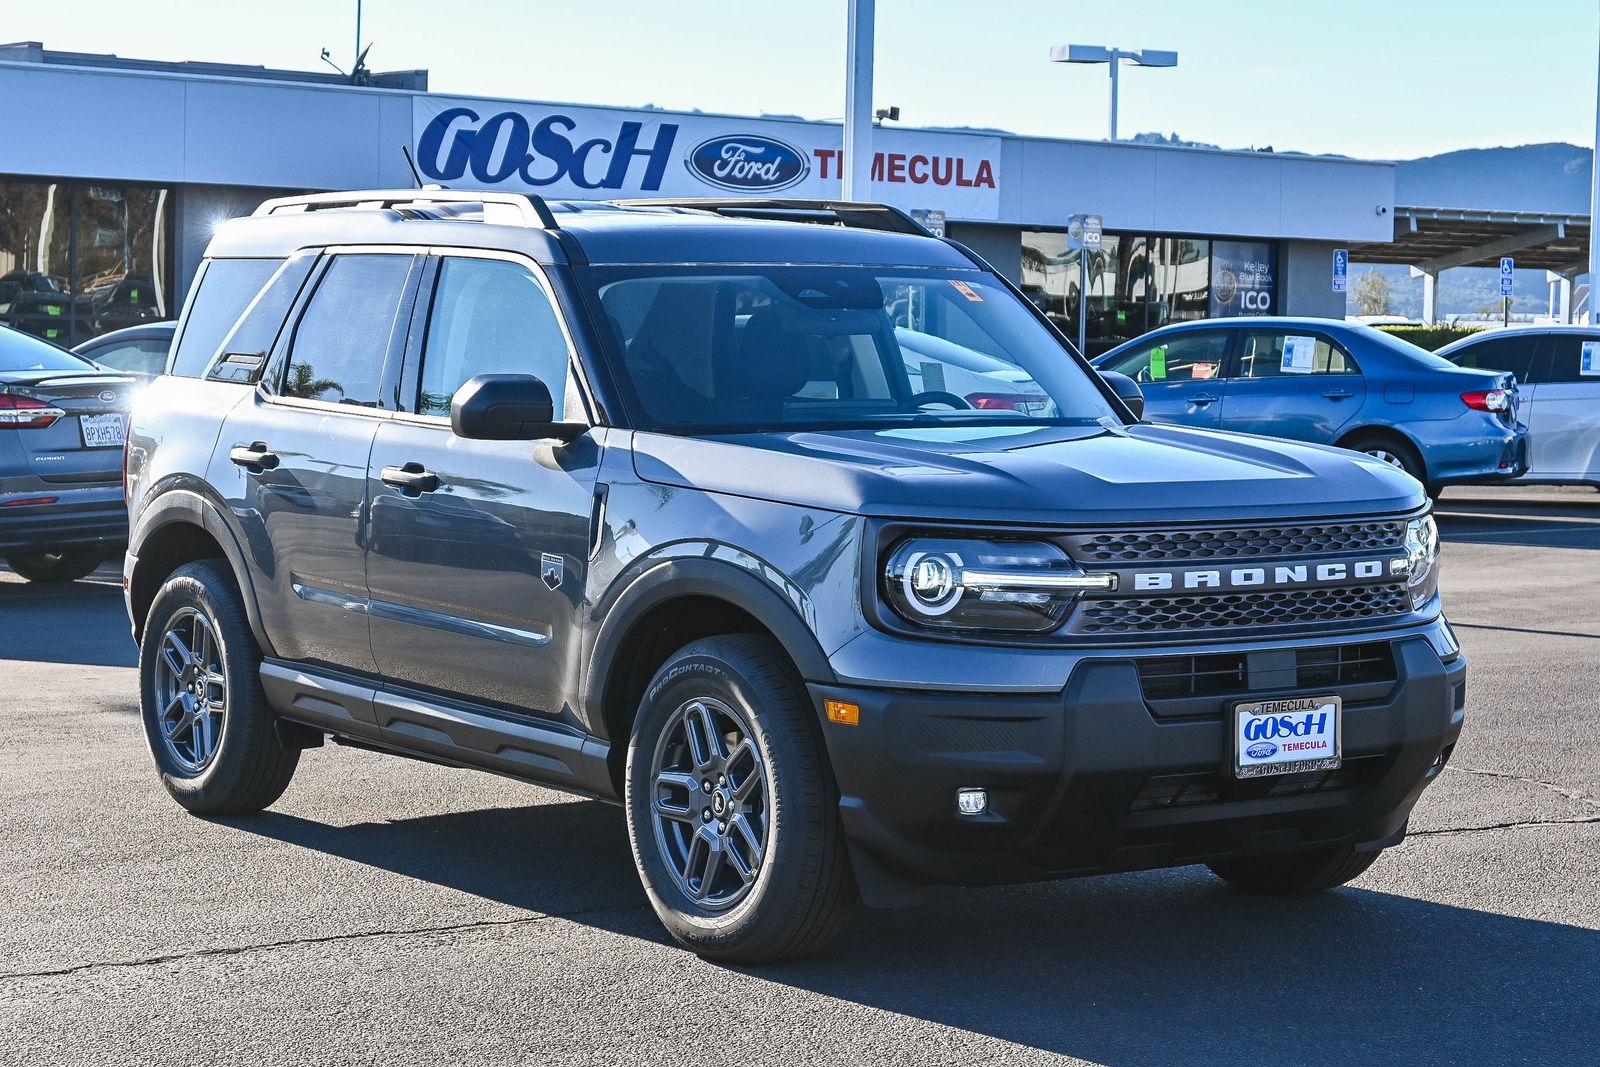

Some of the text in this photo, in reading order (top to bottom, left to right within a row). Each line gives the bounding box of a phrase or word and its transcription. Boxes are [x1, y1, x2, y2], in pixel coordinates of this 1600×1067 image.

[713, 142, 782, 182] Ford
[814, 148, 996, 189] TMECULA
[1084, 232, 1100, 243] ICO
[1244, 261, 1269, 273] Kelley
[1241, 291, 1271, 310] ICO
[1134, 560, 1383, 591] BRONCO
[1260, 699, 1315, 713] TEMECULA
[1251, 740, 1327, 757] Ford TEMECULA
